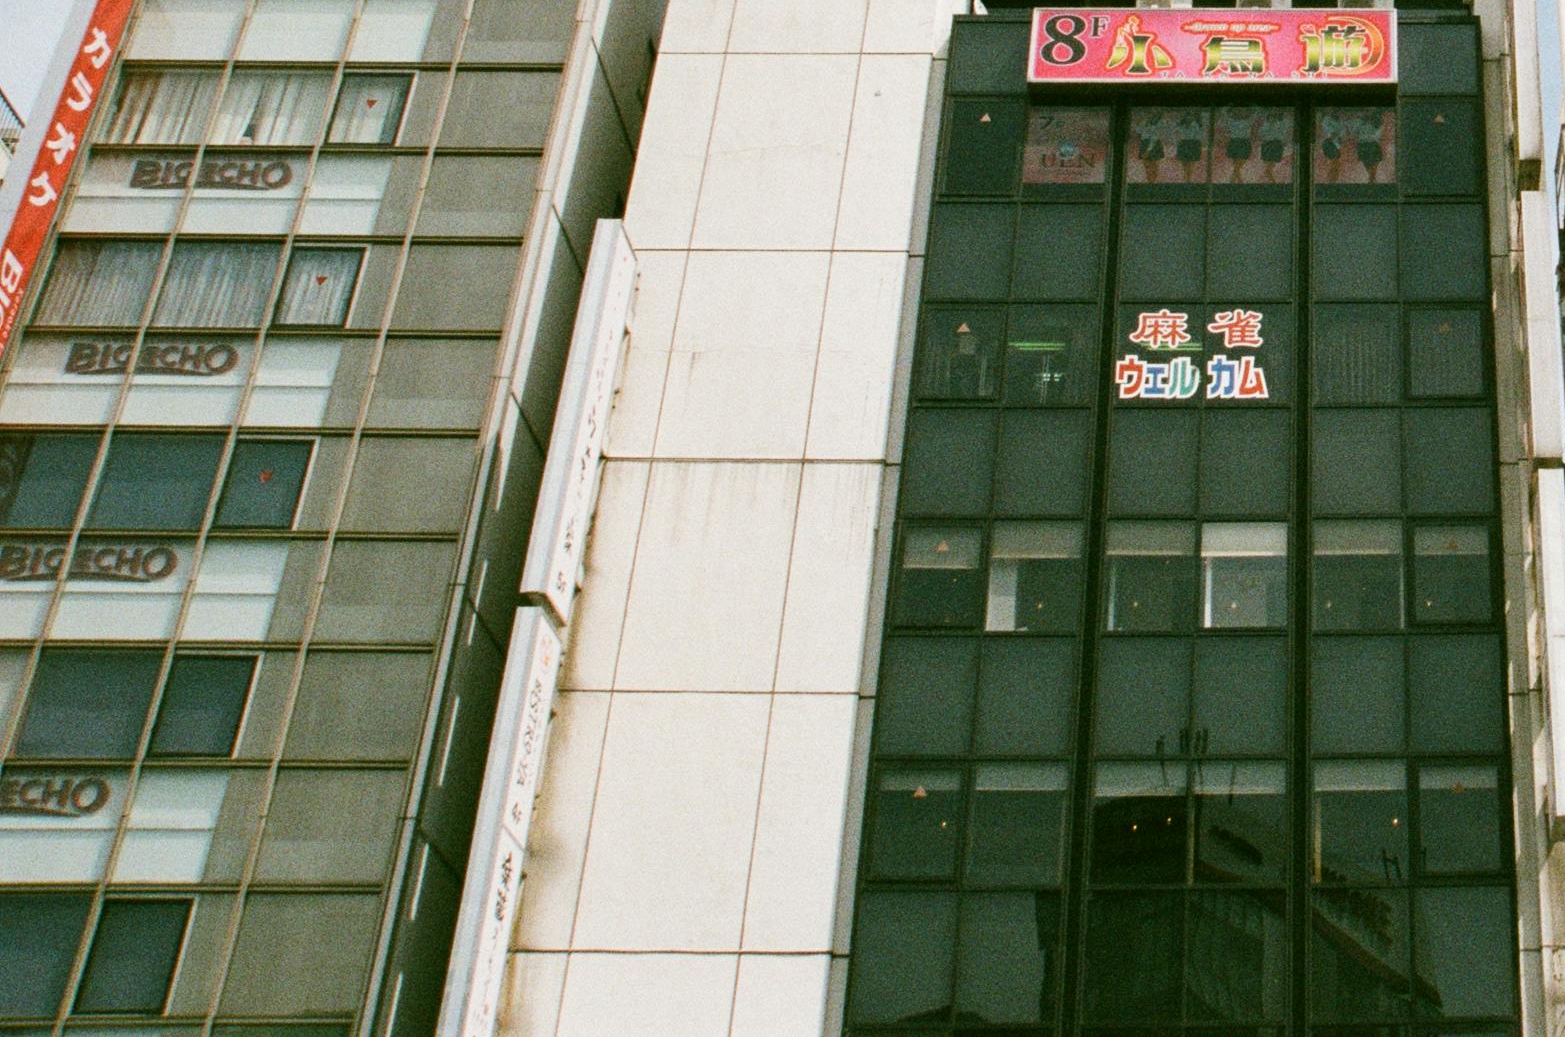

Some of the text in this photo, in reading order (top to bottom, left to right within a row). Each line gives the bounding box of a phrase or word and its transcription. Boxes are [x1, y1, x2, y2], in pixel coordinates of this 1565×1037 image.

[1105, 22, 1383, 76] 小鳥遊
[28, 26, 113, 208] カラオケ
[1130, 309, 1263, 349] 麻雀
[1116, 355, 1269, 399] ウェルカム
